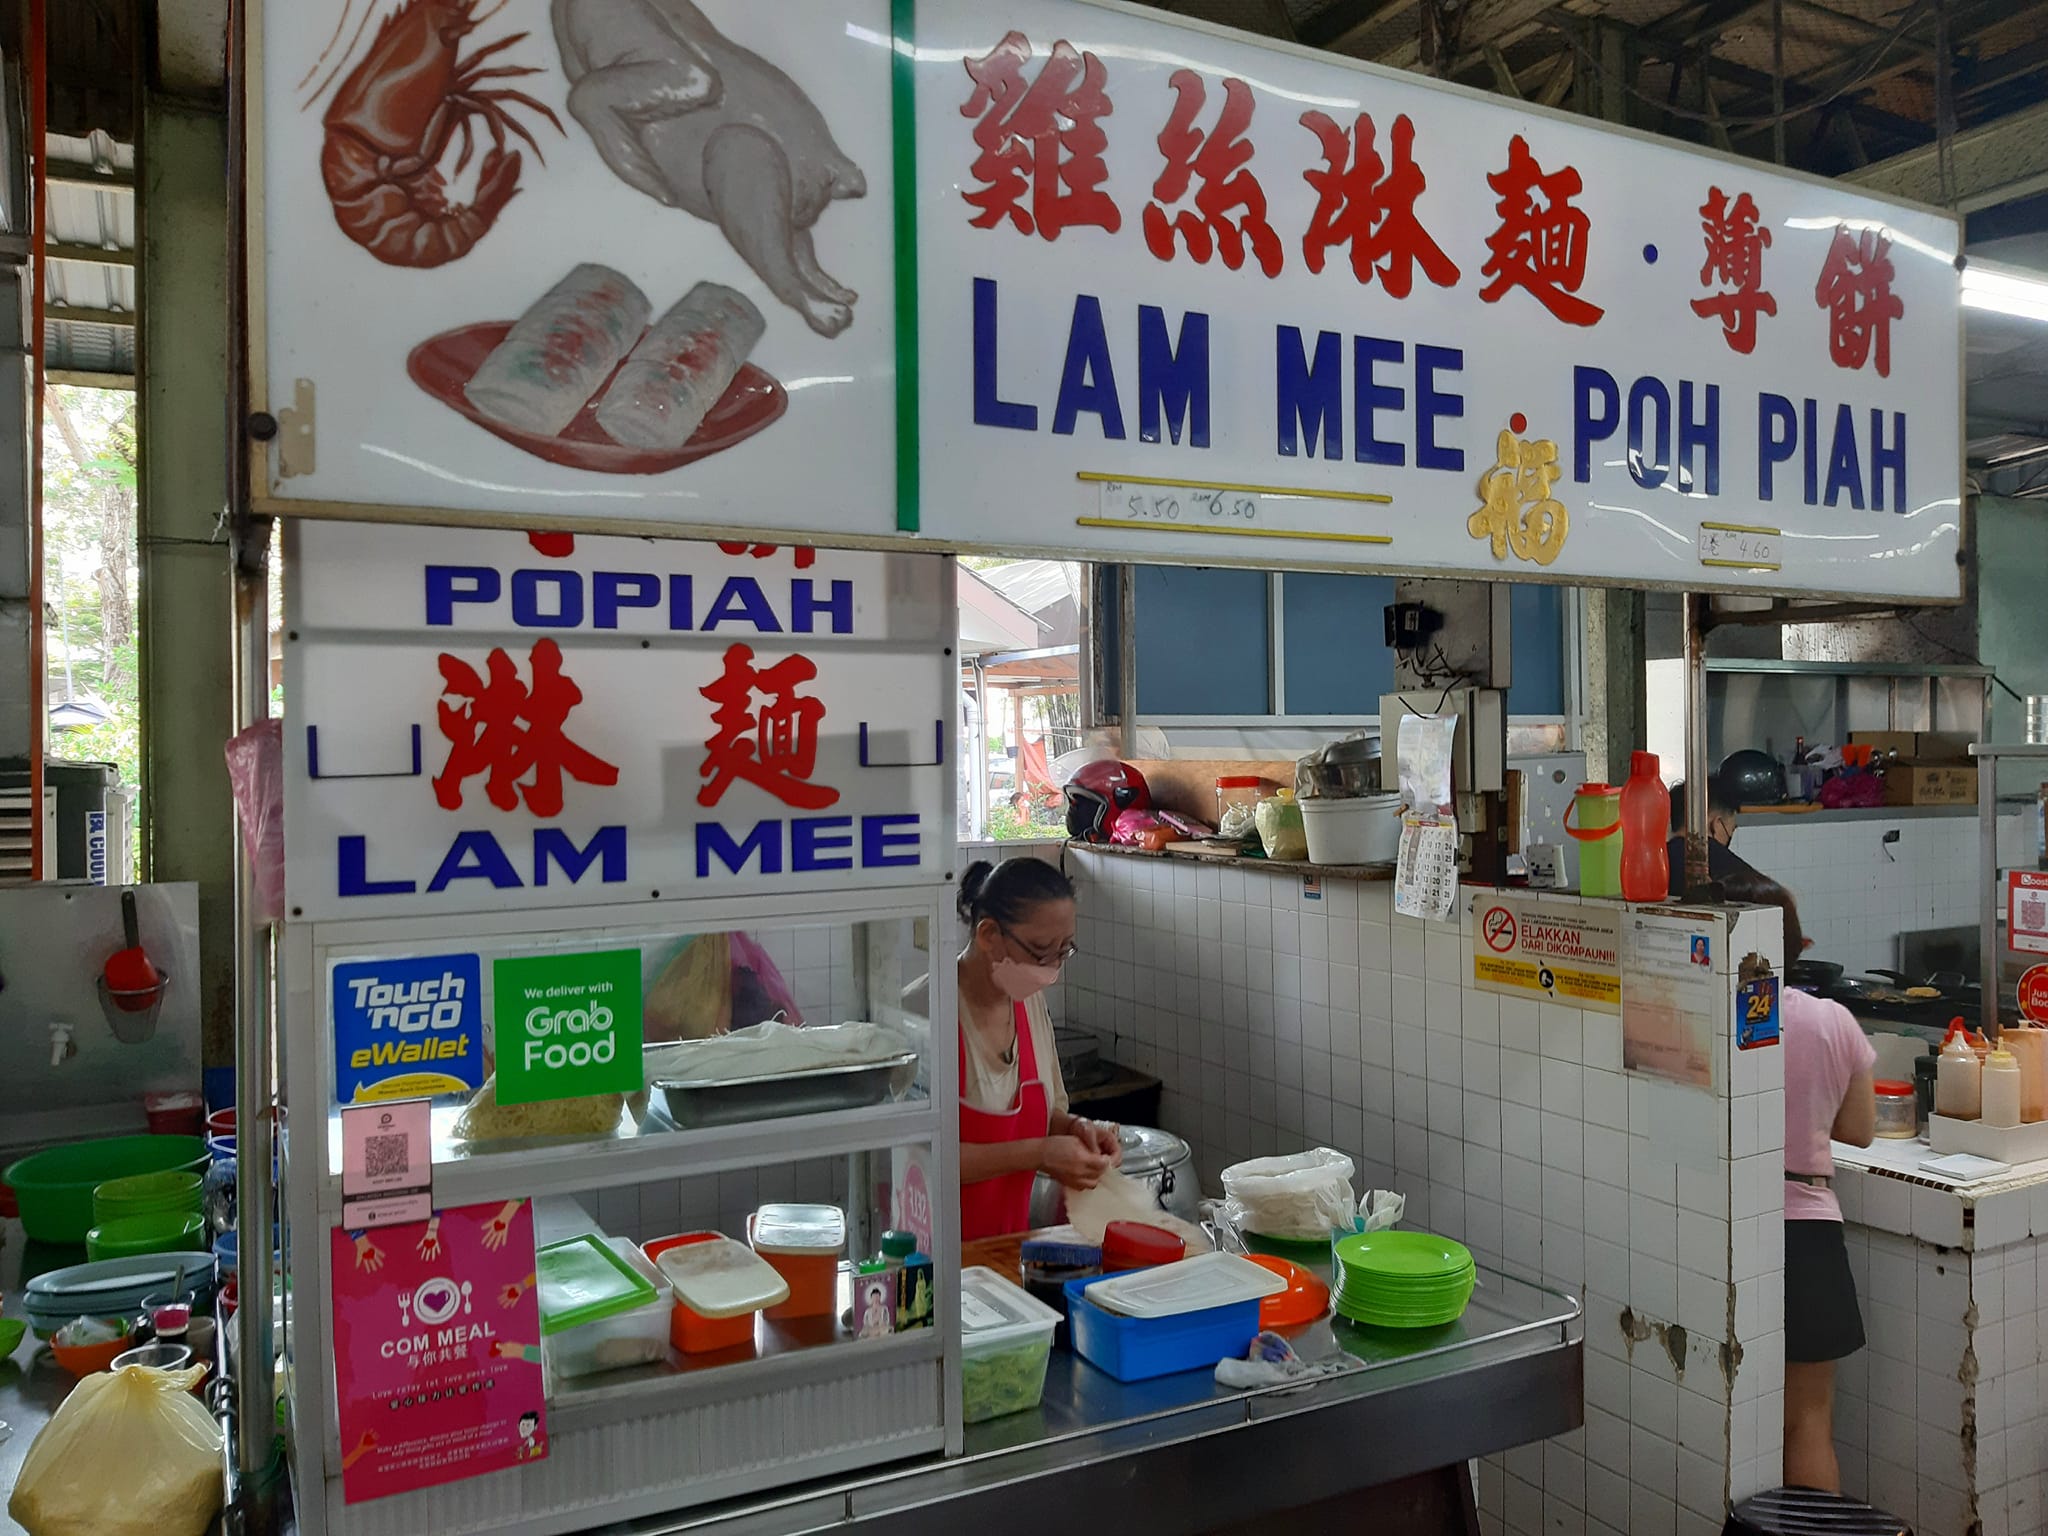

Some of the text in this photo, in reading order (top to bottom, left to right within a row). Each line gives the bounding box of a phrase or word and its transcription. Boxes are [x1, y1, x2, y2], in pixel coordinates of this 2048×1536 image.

[974, 278, 1907, 513] LAM MEE POH PIAH
[1127, 495, 1180, 519] 5.50
[1209, 490, 1255, 519] 6.50
[1467, 429, 1570, 566] 福
[426, 566, 853, 634] POPIAH
[338, 814, 921, 897] LAM MEE
[1521, 925, 1581, 945] ELAKKAN
[1521, 940, 1544, 952] DARI
[348, 971, 466, 1009] Touch
[524, 981, 613, 999] We deliver with
[1746, 994, 1771, 1019] 24
[525, 1000, 613, 1038] Grab
[351, 1033, 469, 1069] eWallet
[525, 1030, 615, 1071] Food
[380, 1321, 496, 1358] COM MEAL
